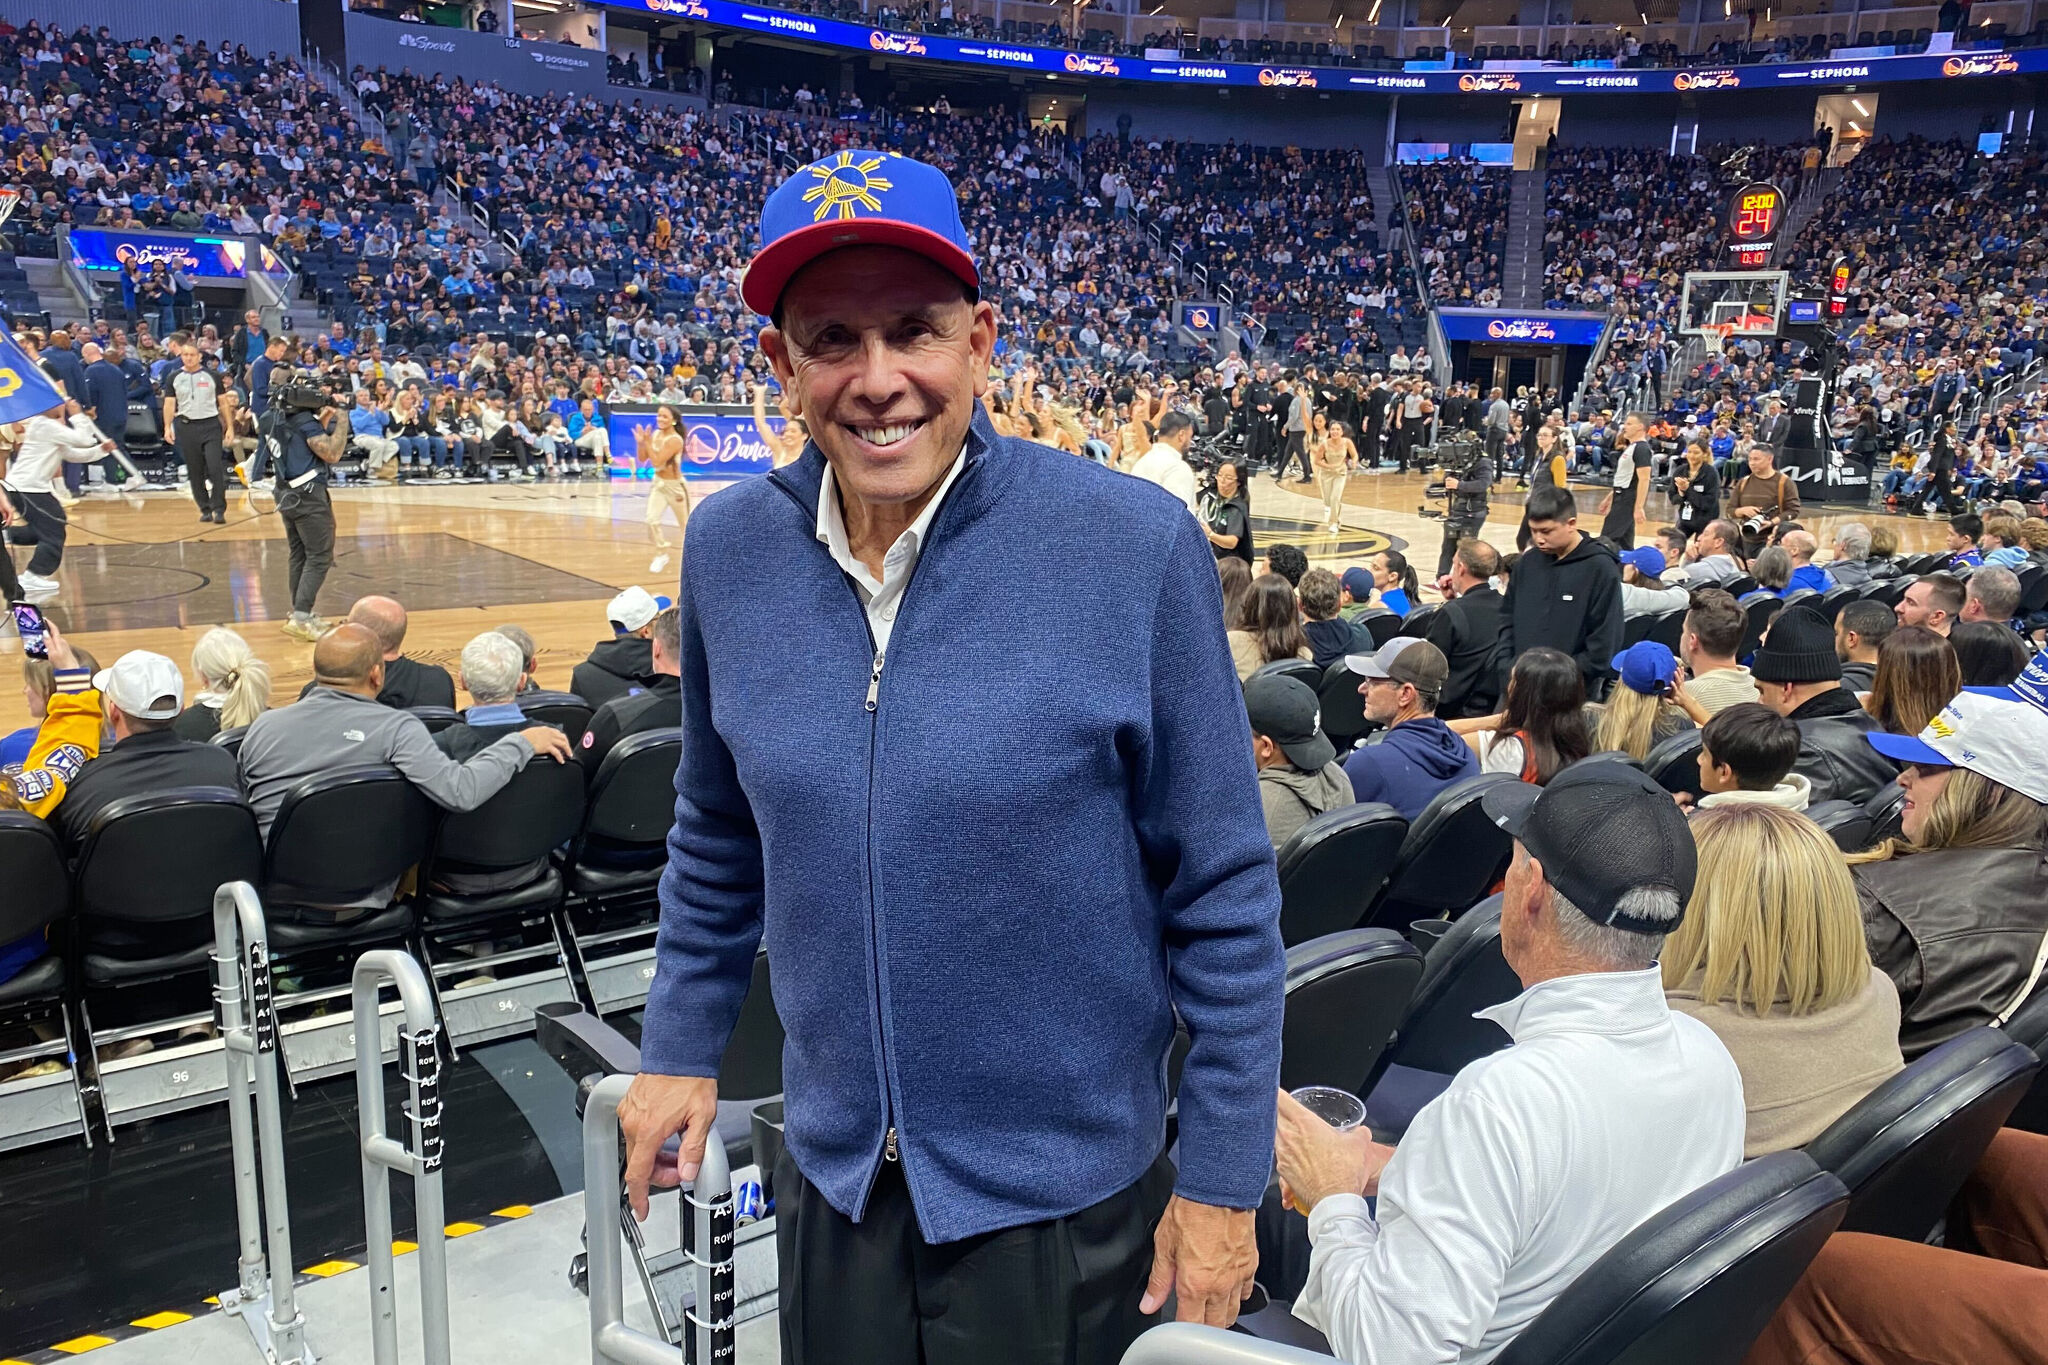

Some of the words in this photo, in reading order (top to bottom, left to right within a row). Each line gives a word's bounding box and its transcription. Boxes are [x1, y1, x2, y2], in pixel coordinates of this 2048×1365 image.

[769, 16, 817, 34] SEPHORA
[415, 36, 456, 52] Sports
[504, 38, 521, 48] 104
[545, 55, 589, 68] DOORDASH
[987, 48, 1034, 63] SEPHORA
[1179, 67, 1227, 79] SEPHORA
[1810, 66, 1869, 79] SEPHORA
[1377, 76, 1426, 88] SEPHORA
[1585, 77, 1638, 87] SEPHORA
[1743, 194, 1775, 210] 12:00
[1738, 209, 1772, 234] 24
[1741, 252, 1764, 264] 0:10
[1794, 406, 1816, 416] xfinity
[254, 975, 268, 987] A1
[255, 993, 269, 1001] ROW
[498, 1000, 513, 1011] 94
[257, 1007, 270, 1018] A1
[258, 1025, 271, 1033] ROW
[259, 1038, 273, 1050] A1
[418, 1055, 435, 1066] ROW
[172, 1070, 189, 1083] 96
[420, 1074, 437, 1088] A2
[421, 1096, 437, 1107] ROW
[424, 1136, 440, 1147] ROW
[713, 1231, 733, 1246] ROW
[714, 1287, 733, 1302] ROW
[714, 1343, 734, 1358] ROW
